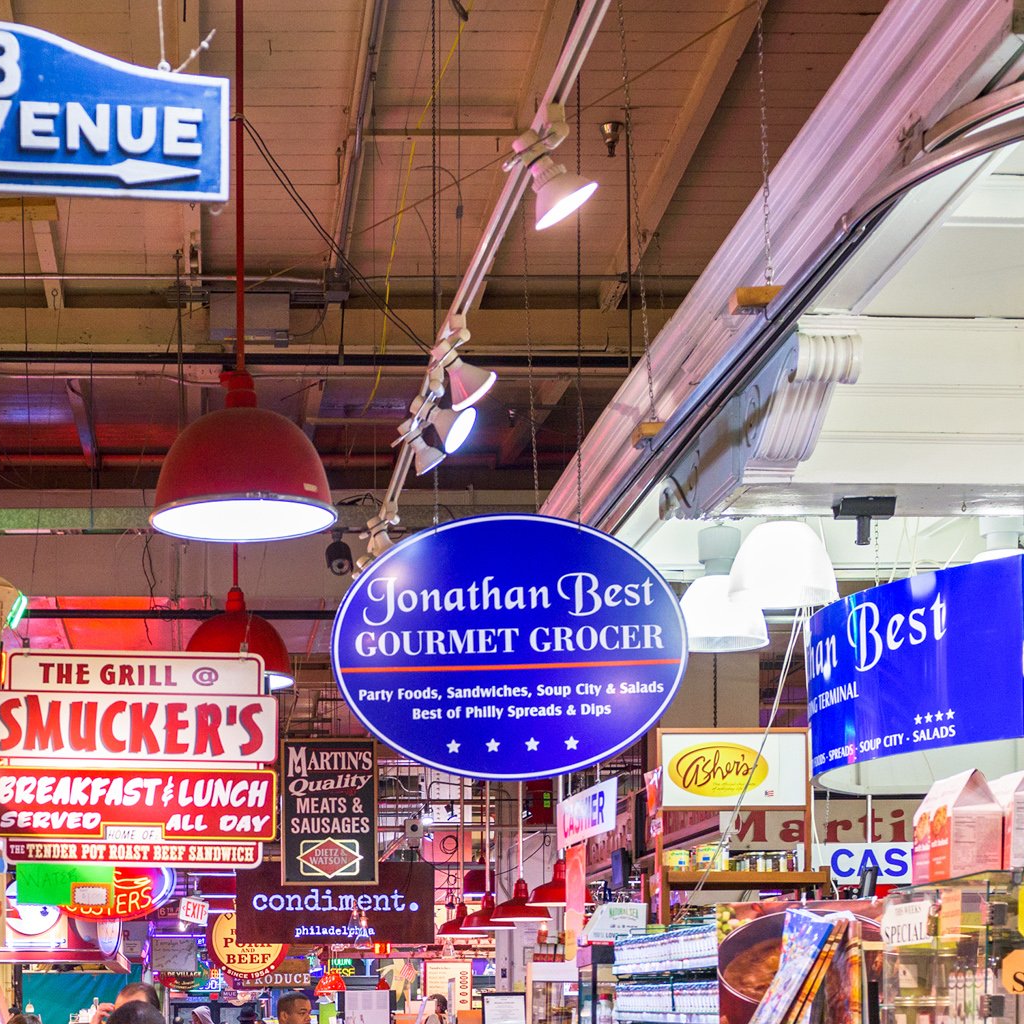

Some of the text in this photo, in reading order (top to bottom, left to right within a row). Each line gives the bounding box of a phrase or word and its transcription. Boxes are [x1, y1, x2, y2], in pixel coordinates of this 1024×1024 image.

[362, 571, 655, 626] Jonathan Best
[354, 623, 665, 658] GOURMET GROCER
[847, 592, 949, 673] Best
[38, 662, 219, 687] THE GRILL @
[358, 680, 665, 703] Party Foods, Sandwiches, Soup City & Salads
[818, 681, 860, 711] TERMINAL
[412, 703, 613, 721] Best of Philly Spreads & Dips
[859, 737, 882, 753] SOUP
[883, 733, 905, 748] CITY
[912, 724, 957, 743] SALADS
[287, 746, 373, 778] MARTIN'S
[177, 777, 269, 809] LUNCH
[288, 774, 373, 796] Quality
[296, 797, 364, 815] MEATS &
[0, 810, 271, 833] SERVED ALL DAY
[290, 816, 371, 835] SAUSAGES
[108, 829, 136, 840] HOME
[9, 843, 255, 862] THE TENDER POT ROAST BEEF SANDWICH
[309, 856, 349, 865] WATSON
[314, 847, 339, 857] DIETZ
[831, 848, 914, 878] CAS
[185, 901, 206, 921] EXIT
[251, 888, 420, 912] condiment.
[294, 925, 376, 938] philadelphia
[884, 921, 930, 945] SPECIAL
[226, 953, 271, 965] BEEF
[226, 969, 270, 979] SINCE 1954
